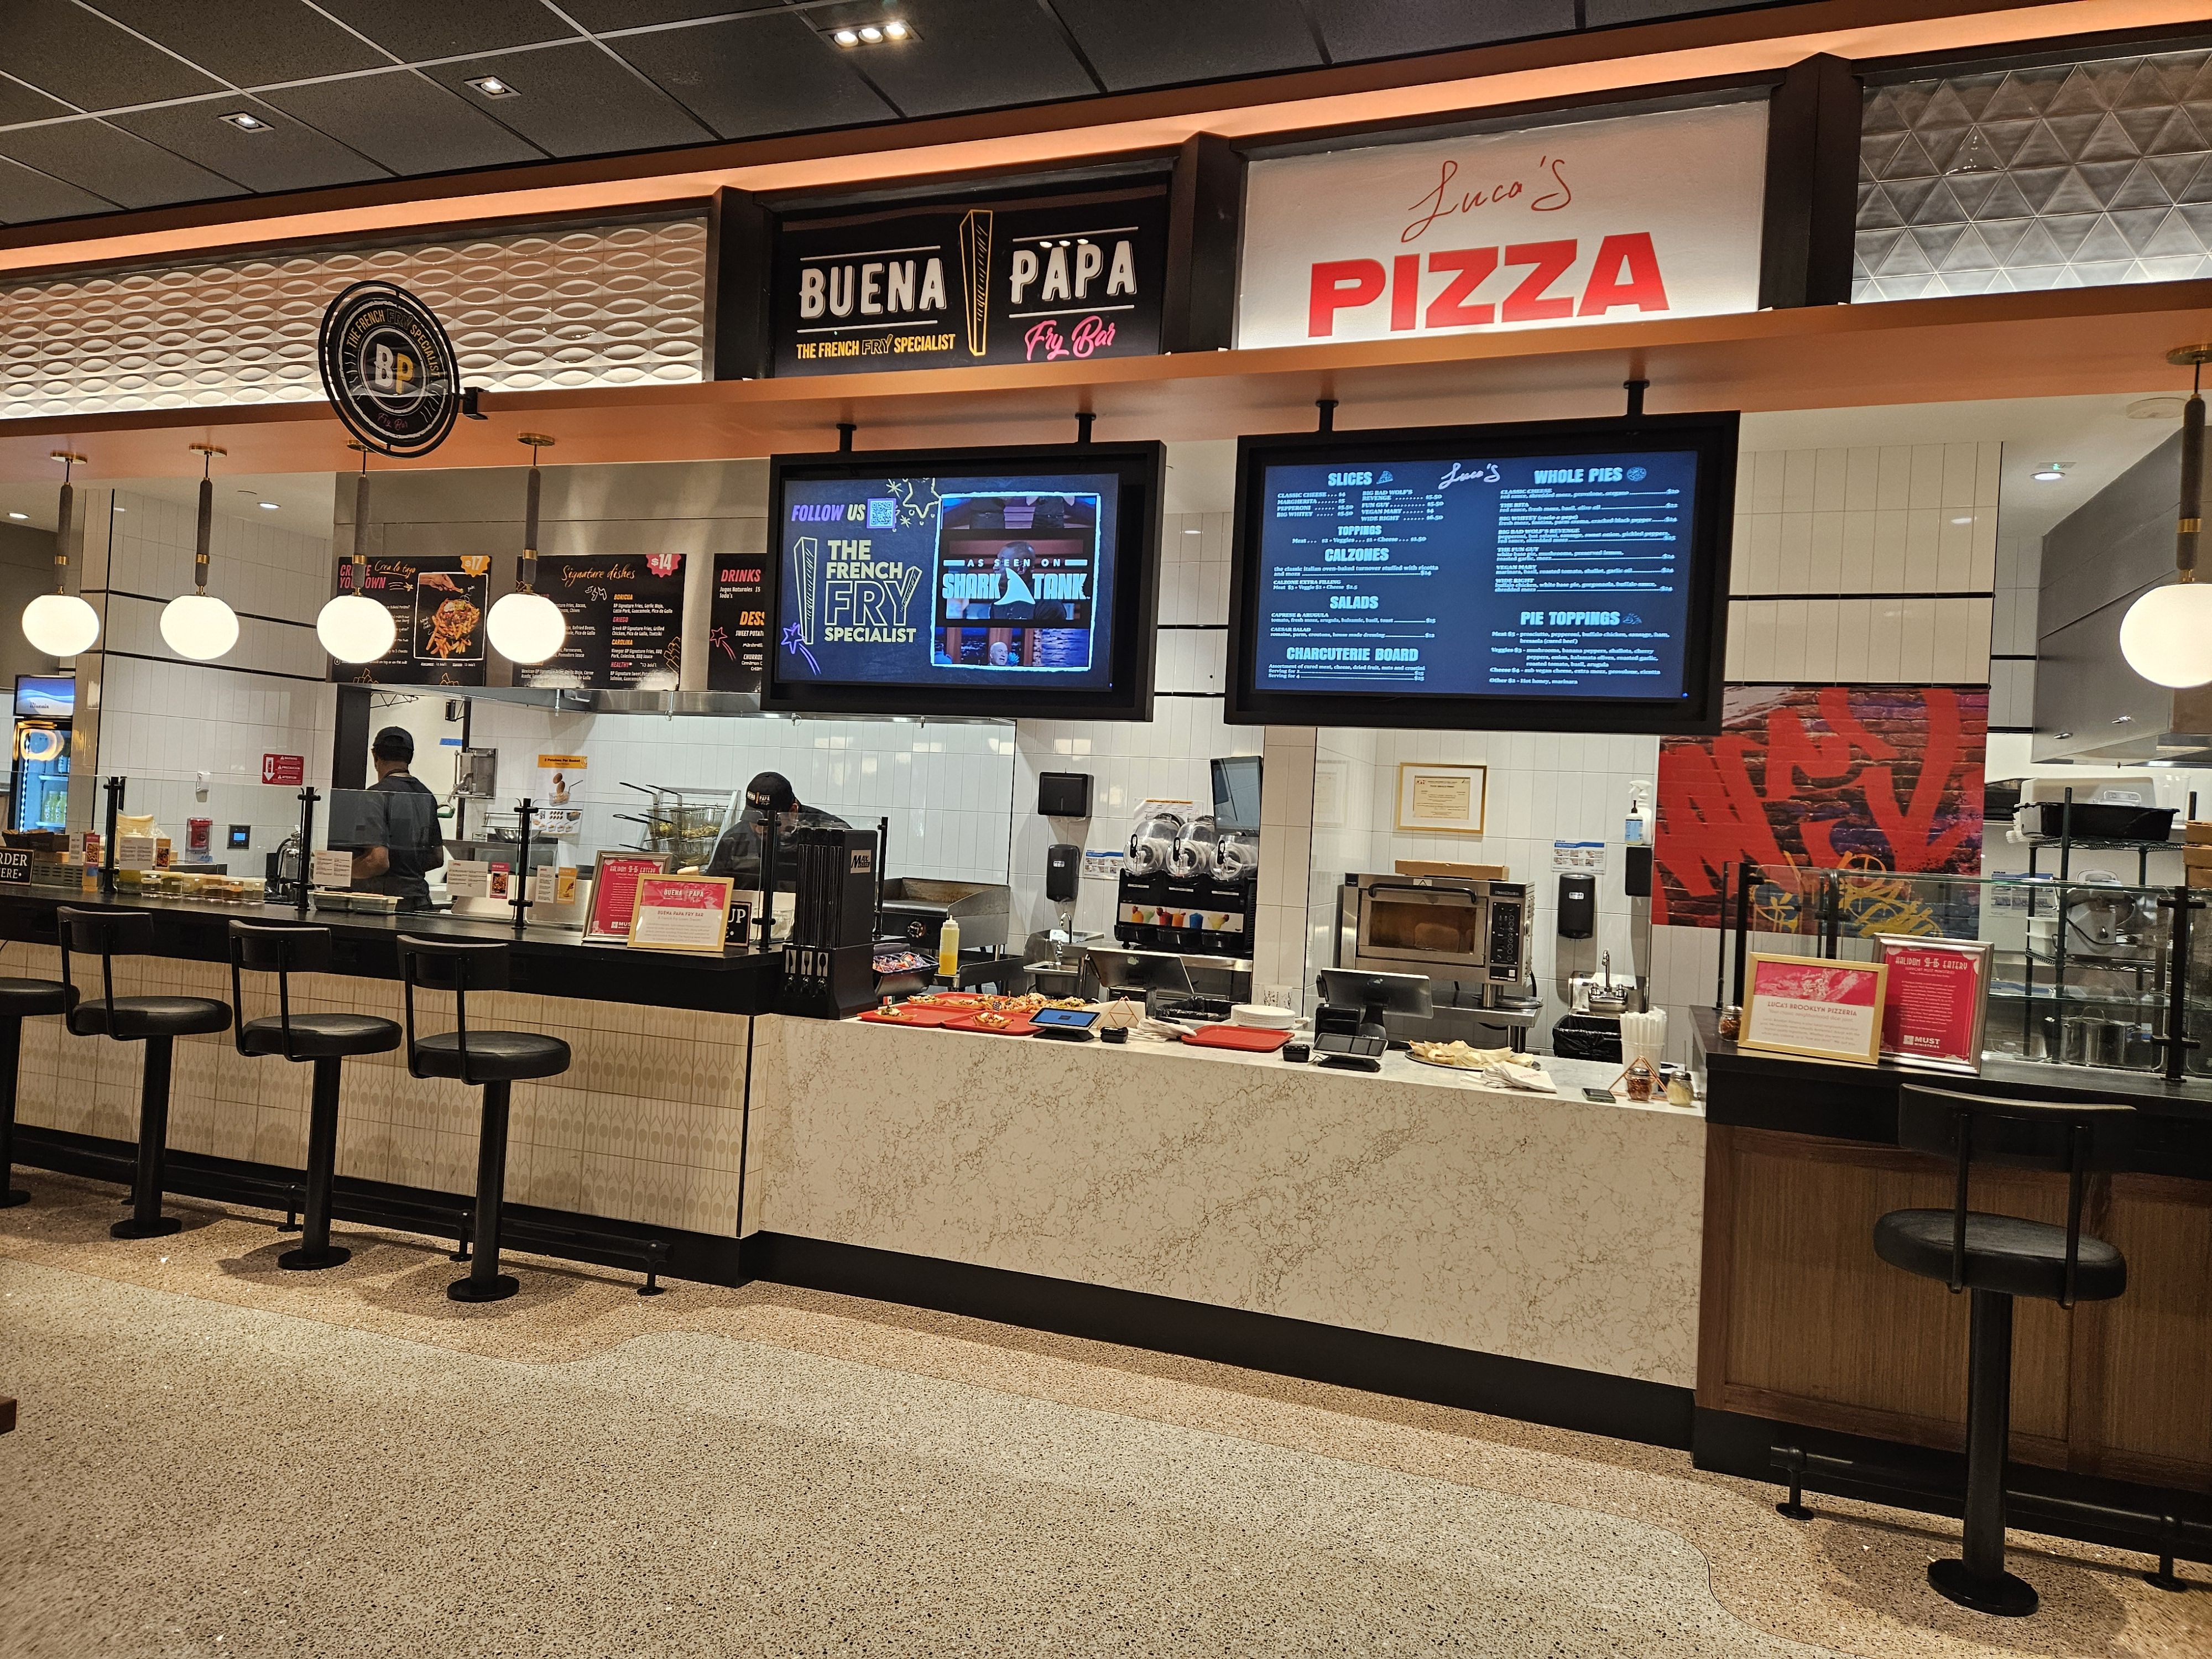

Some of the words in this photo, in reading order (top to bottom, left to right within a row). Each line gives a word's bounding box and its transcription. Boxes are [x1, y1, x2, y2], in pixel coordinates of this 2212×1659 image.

[799, 258, 946, 319] BUENA
[1308, 232, 1670, 337] PIZZA
[347, 325, 361, 348] THE
[355, 309, 385, 332] FRENCH
[387, 309, 414, 330] FRY
[410, 324, 441, 378] SPECIALIST
[1025, 320, 1068, 361] Fry
[1072, 315, 1116, 358] Bar
[797, 343, 817, 358] THE
[818, 341, 859, 357] FRENCH
[862, 335, 893, 355] FRY
[895, 334, 955, 353] SPECIALIST
[374, 343, 414, 394] BP
[1328, 472, 1373, 486] SLICES
[1534, 469, 1584, 484] WHOLE
[1588, 467, 1623, 482] PIES
[791, 504, 845, 521] FOLLOW
[847, 504, 866, 521] US
[1338, 525, 1382, 535] TOPPINGS
[827, 539, 872, 561] THE
[1325, 548, 1389, 561] CALZONES
[464, 556, 483, 570] $17
[651, 554, 672, 570] $14
[993, 558, 1031, 567] SEEN
[340, 565, 372, 576] CRE
[561, 565, 605, 588] Signature
[607, 563, 635, 580] dishes
[721, 569, 761, 582] DRINKS
[826, 562, 902, 579] FRENCH
[365, 577, 386, 588] OWN
[942, 572, 1002, 599] SHARK
[1032, 572, 1088, 600] TANK
[824, 566, 923, 627] FRY
[1330, 596, 1379, 609] SALADS
[1521, 612, 1543, 625] PIE
[1549, 612, 1620, 625] TOPPINGS
[824, 628, 916, 643] SPECIALIST
[1286, 647, 1370, 660] CHARCUTERIE
[1375, 648, 1419, 661] BOARD
[1895, 956, 1921, 966] HALIDOM
[1943, 960, 1968, 971] EATERY
[1790, 1003, 1825, 1013] BROOKLYN
[1828, 1008, 1857, 1016] PIZZERIA
